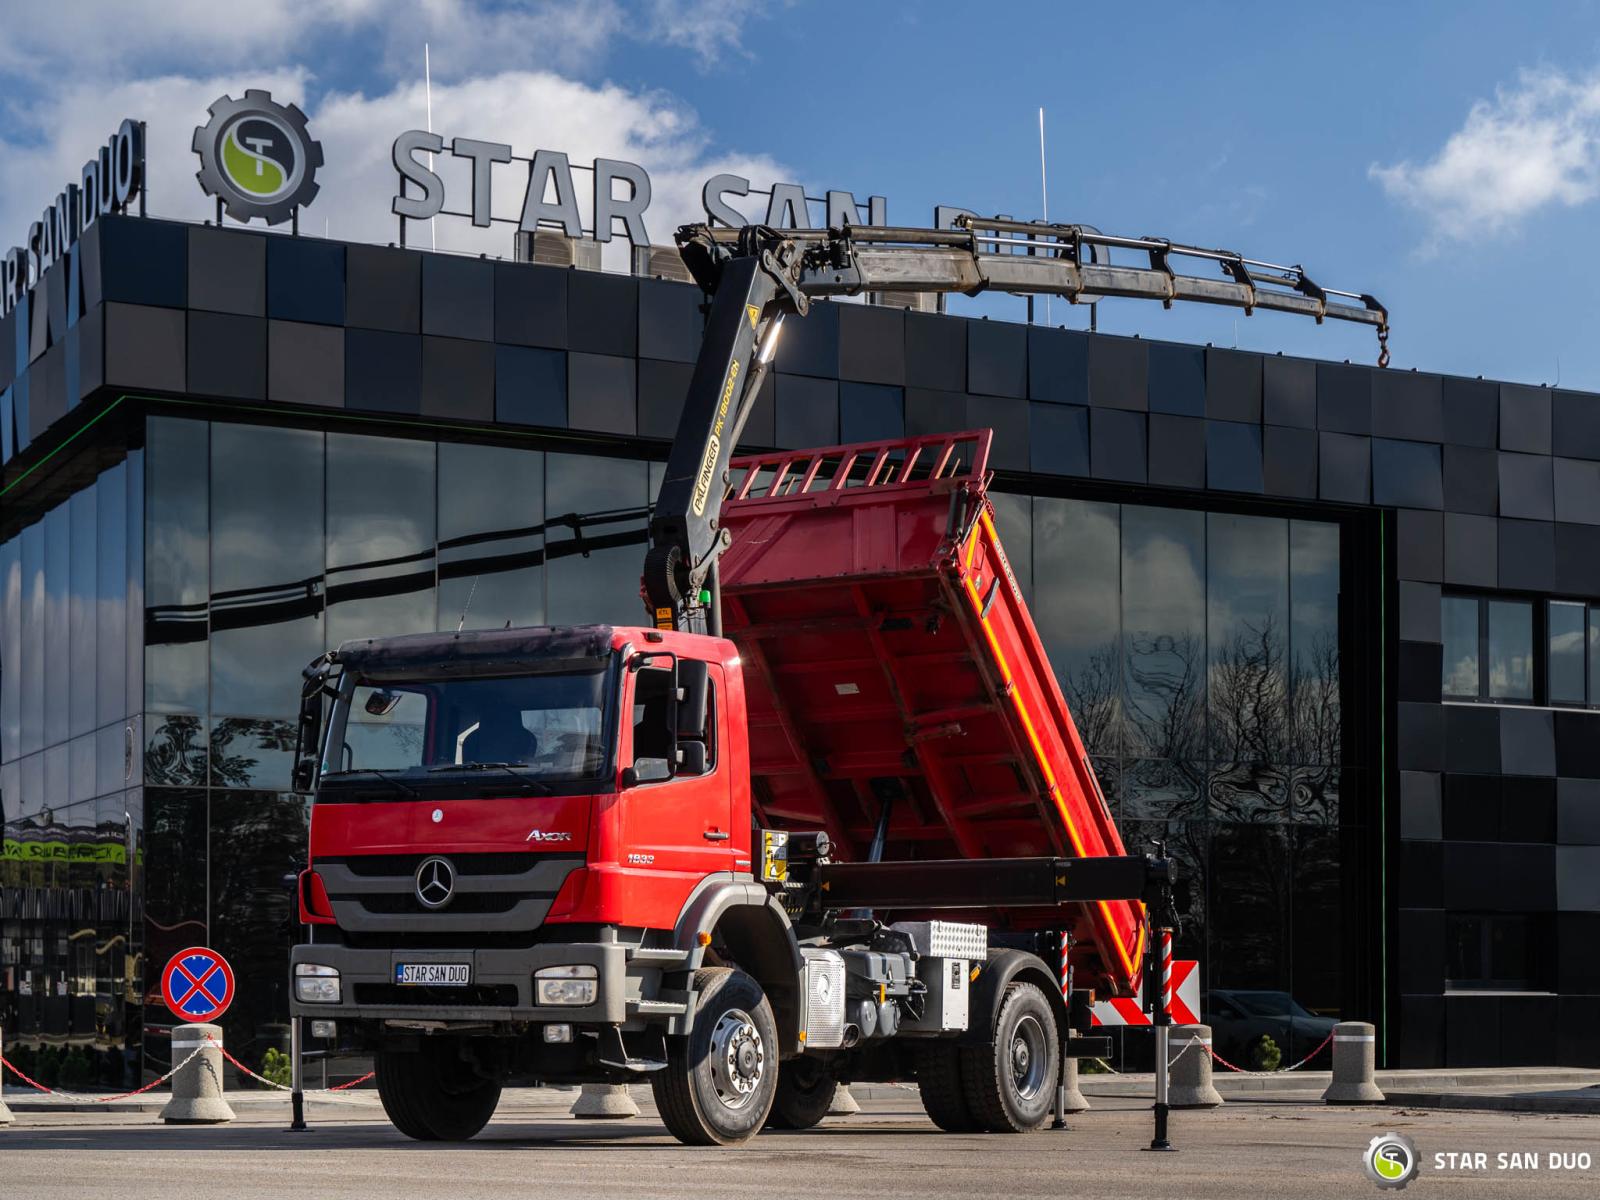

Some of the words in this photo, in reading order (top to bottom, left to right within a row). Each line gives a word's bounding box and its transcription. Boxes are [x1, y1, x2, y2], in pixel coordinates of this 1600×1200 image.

[27, 183, 78, 291] SAN
[82, 118, 142, 232] DUO
[392, 130, 651, 247] STAR
[694, 440, 719, 513] PALFINGER
[404, 966, 427, 981] STAR
[428, 966, 446, 981] SAN
[448, 966, 467, 981] DUO
